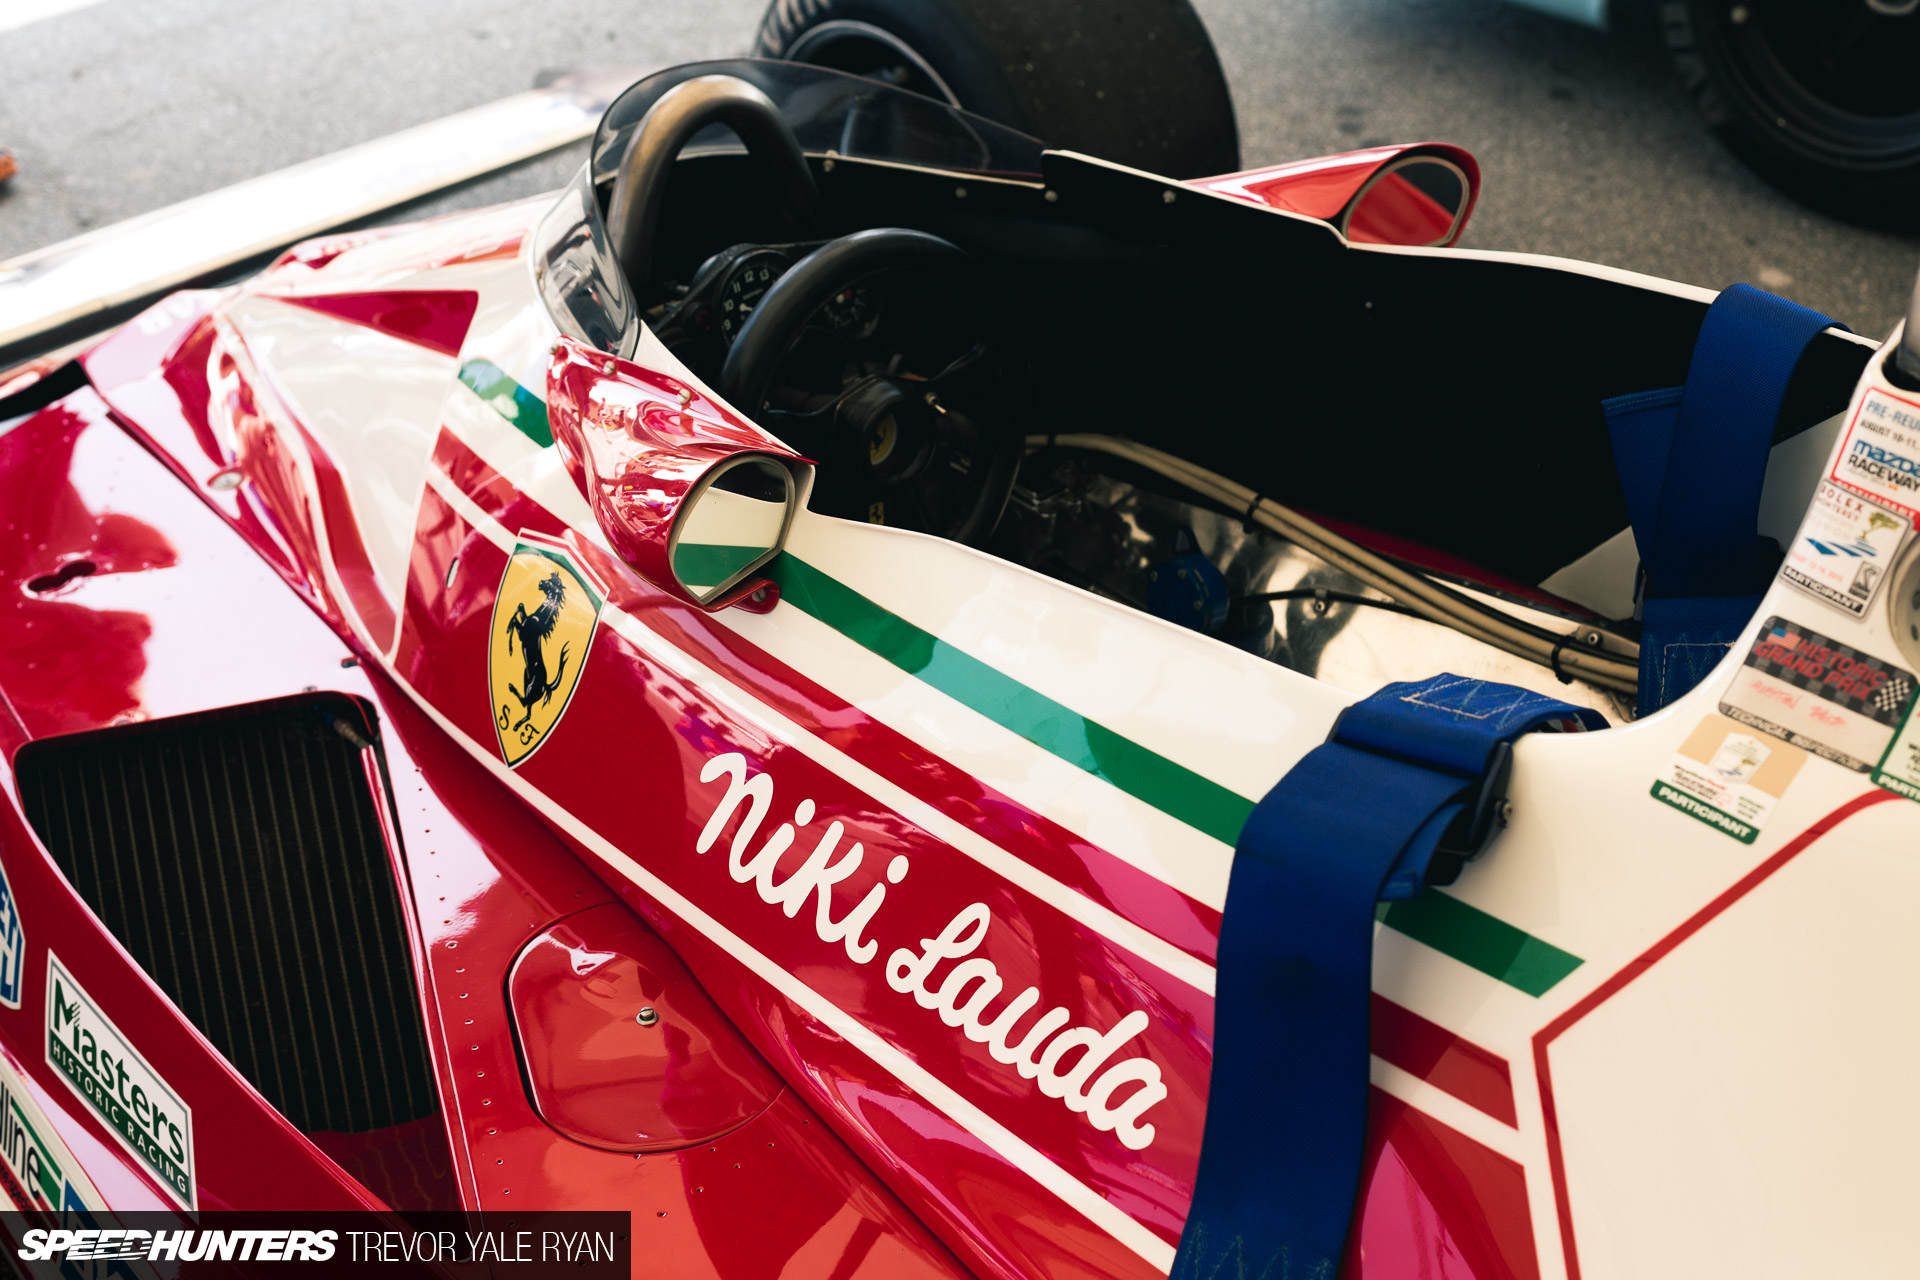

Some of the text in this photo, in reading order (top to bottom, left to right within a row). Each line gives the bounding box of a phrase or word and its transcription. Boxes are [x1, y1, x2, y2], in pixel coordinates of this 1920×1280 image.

[733, 281, 742, 293] 11
[744, 270, 755, 284] 12
[759, 268, 770, 281] 13
[724, 299, 735, 312] 10
[724, 319, 732, 331] 9
[1784, 566, 1861, 611] PARTICIPANT
[1754, 641, 1824, 679] GRAND
[1823, 670, 1877, 701] PRIX
[1796, 639, 1889, 687] HISTORIC
[1727, 706, 1789, 739] TECHNICAL
[1658, 786, 1753, 838] PARTICIPANT
[886, 902, 1168, 1150] Lauda
[54, 979, 187, 1165] Masters
[52, 1042, 188, 1194] HISTORIC RACING
